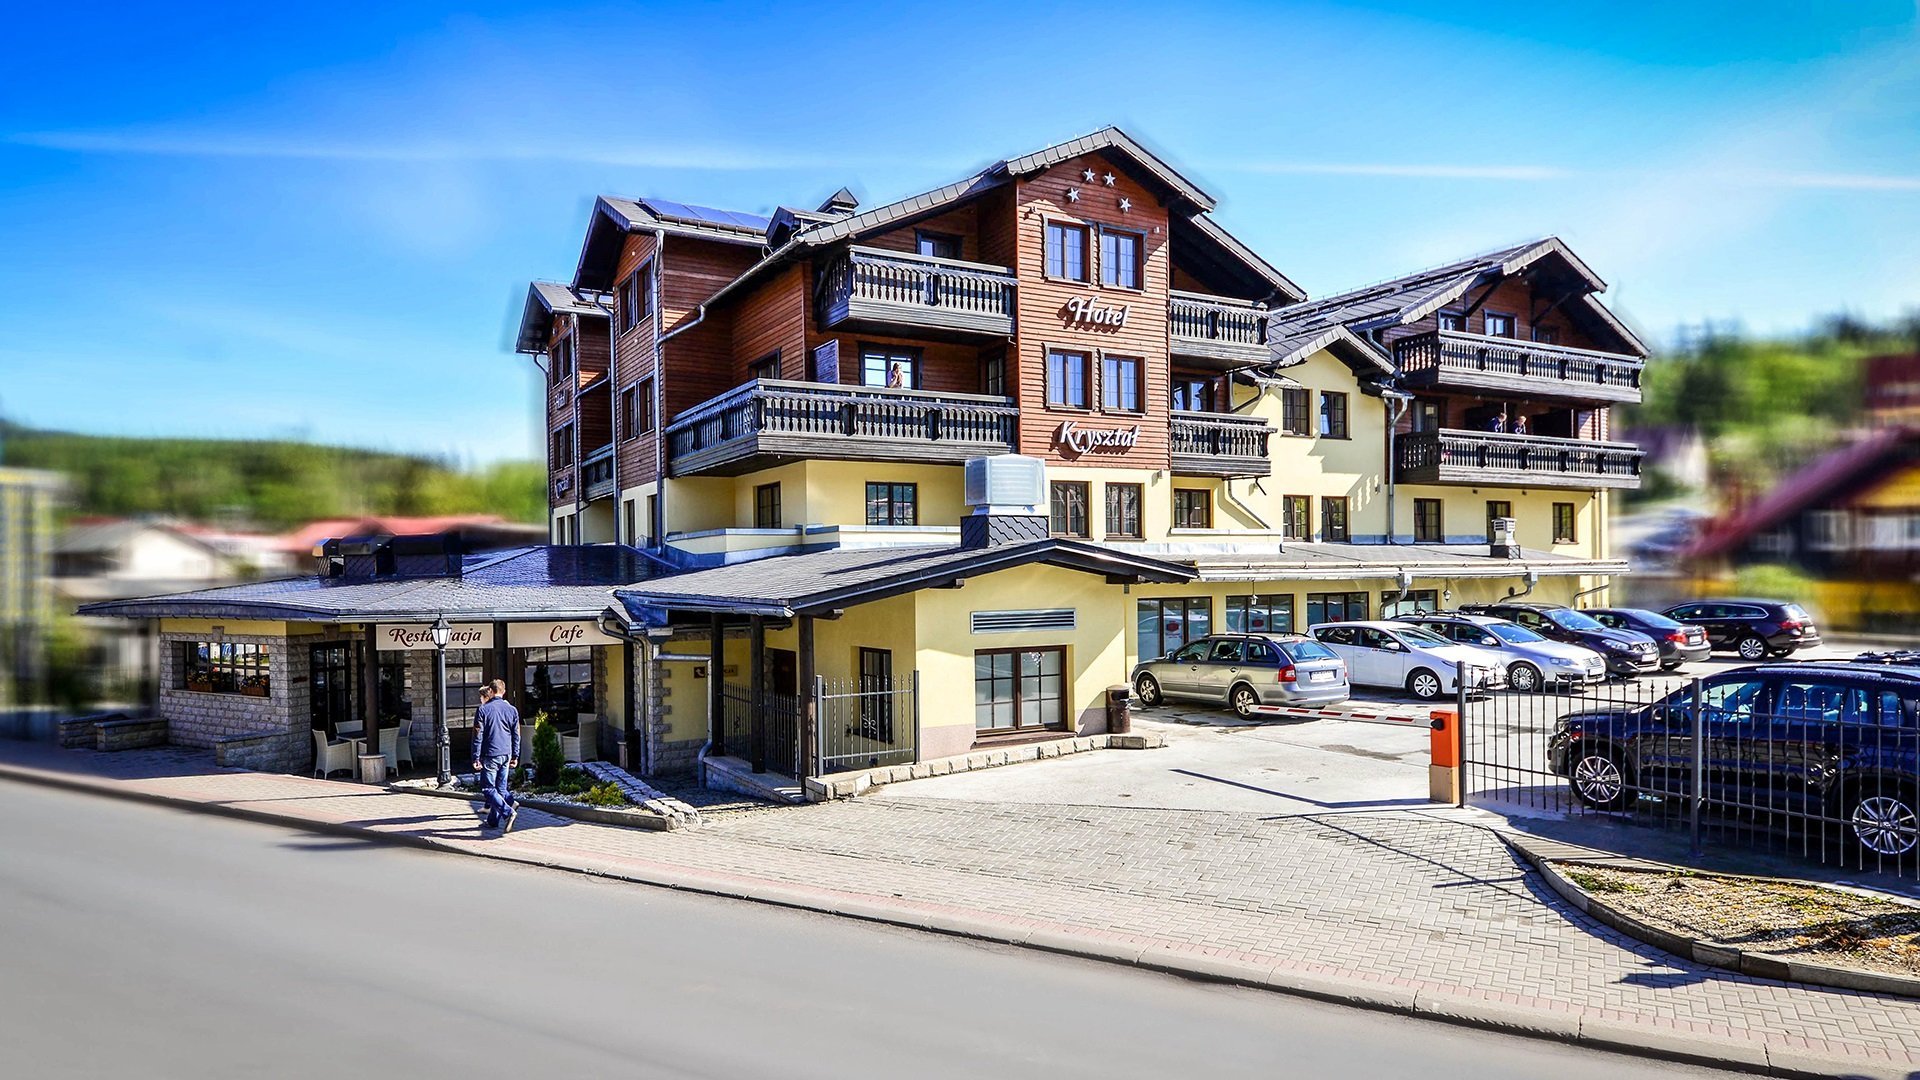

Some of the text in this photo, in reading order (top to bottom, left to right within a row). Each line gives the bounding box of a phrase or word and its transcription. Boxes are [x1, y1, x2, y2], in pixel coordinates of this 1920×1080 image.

[1068, 296, 1130, 327] Hotel
[1060, 421, 1141, 453] Kryształ
[389, 628, 481, 647] Restaacja
[550, 624, 583, 644] Cafe
